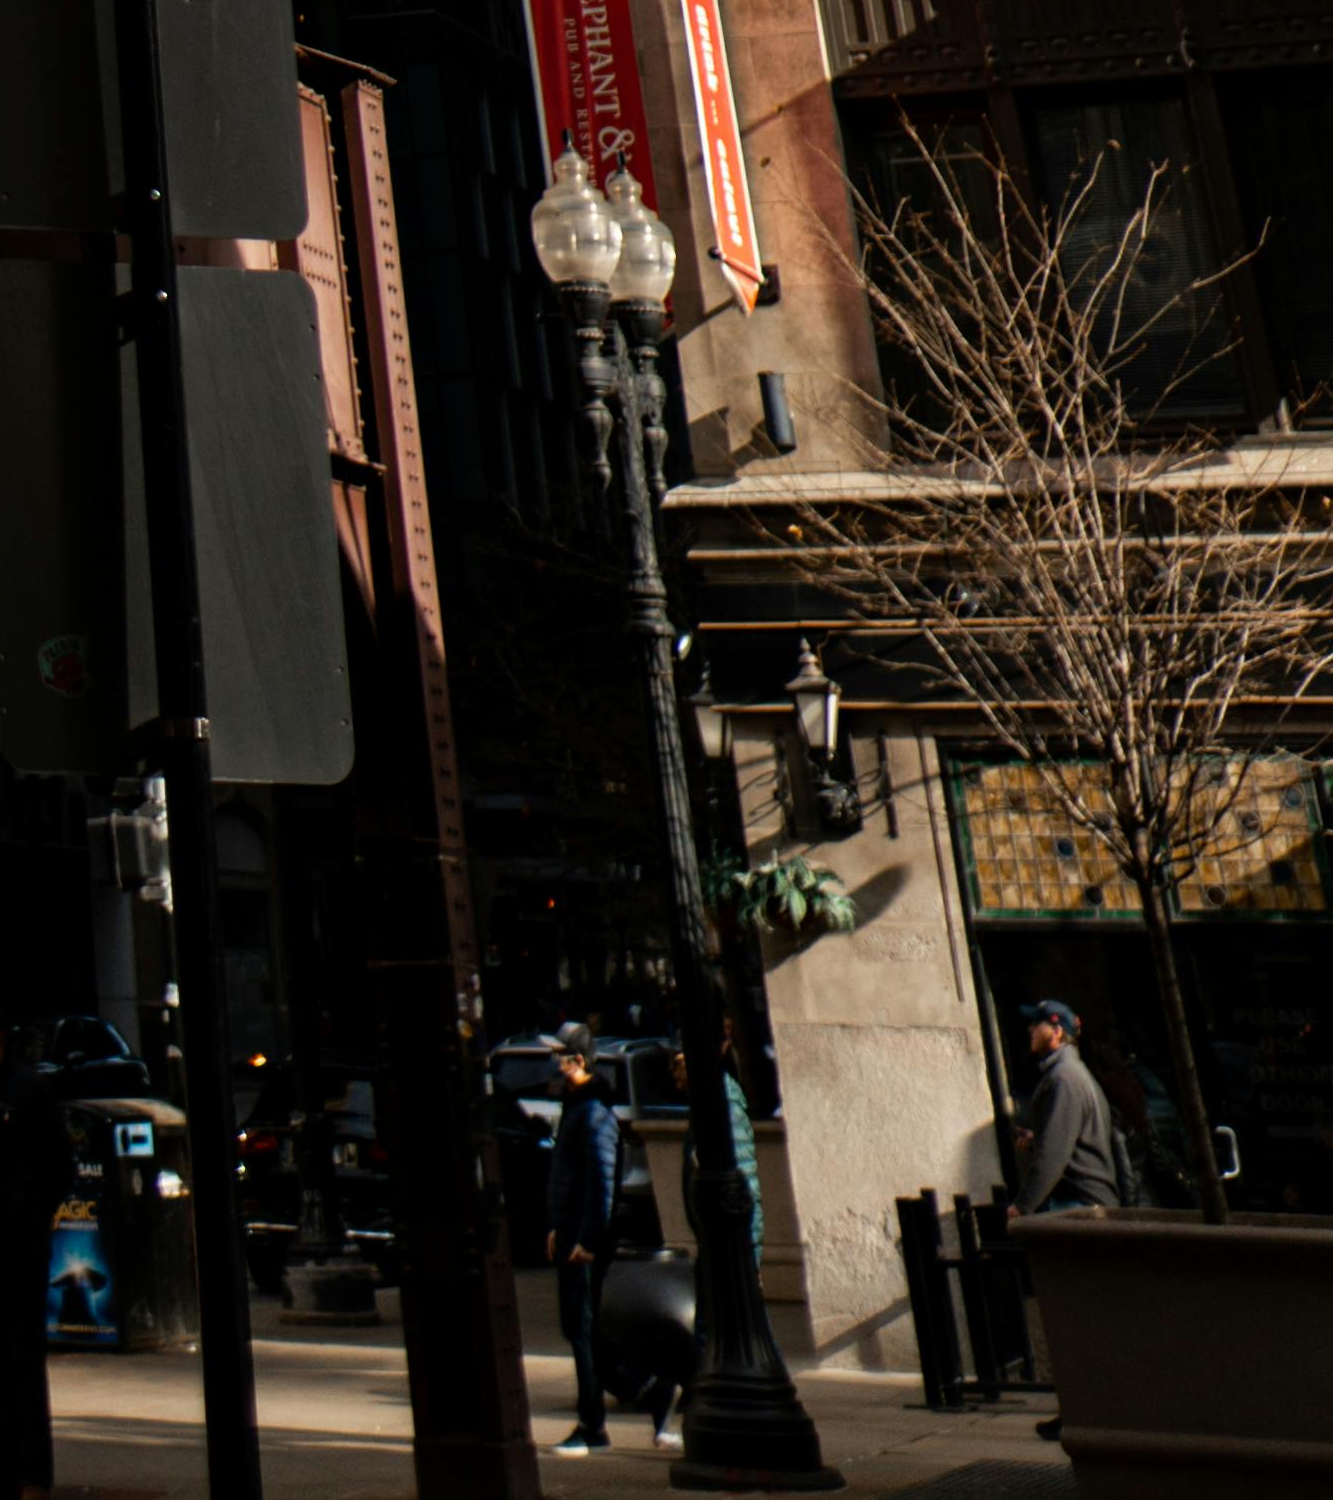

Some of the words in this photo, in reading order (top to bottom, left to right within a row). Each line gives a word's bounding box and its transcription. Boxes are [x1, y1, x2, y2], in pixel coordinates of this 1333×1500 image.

[563, 17, 580, 52] PUB
[569, 61, 585, 99] AND
[55, 1200, 99, 1224] AGIC
